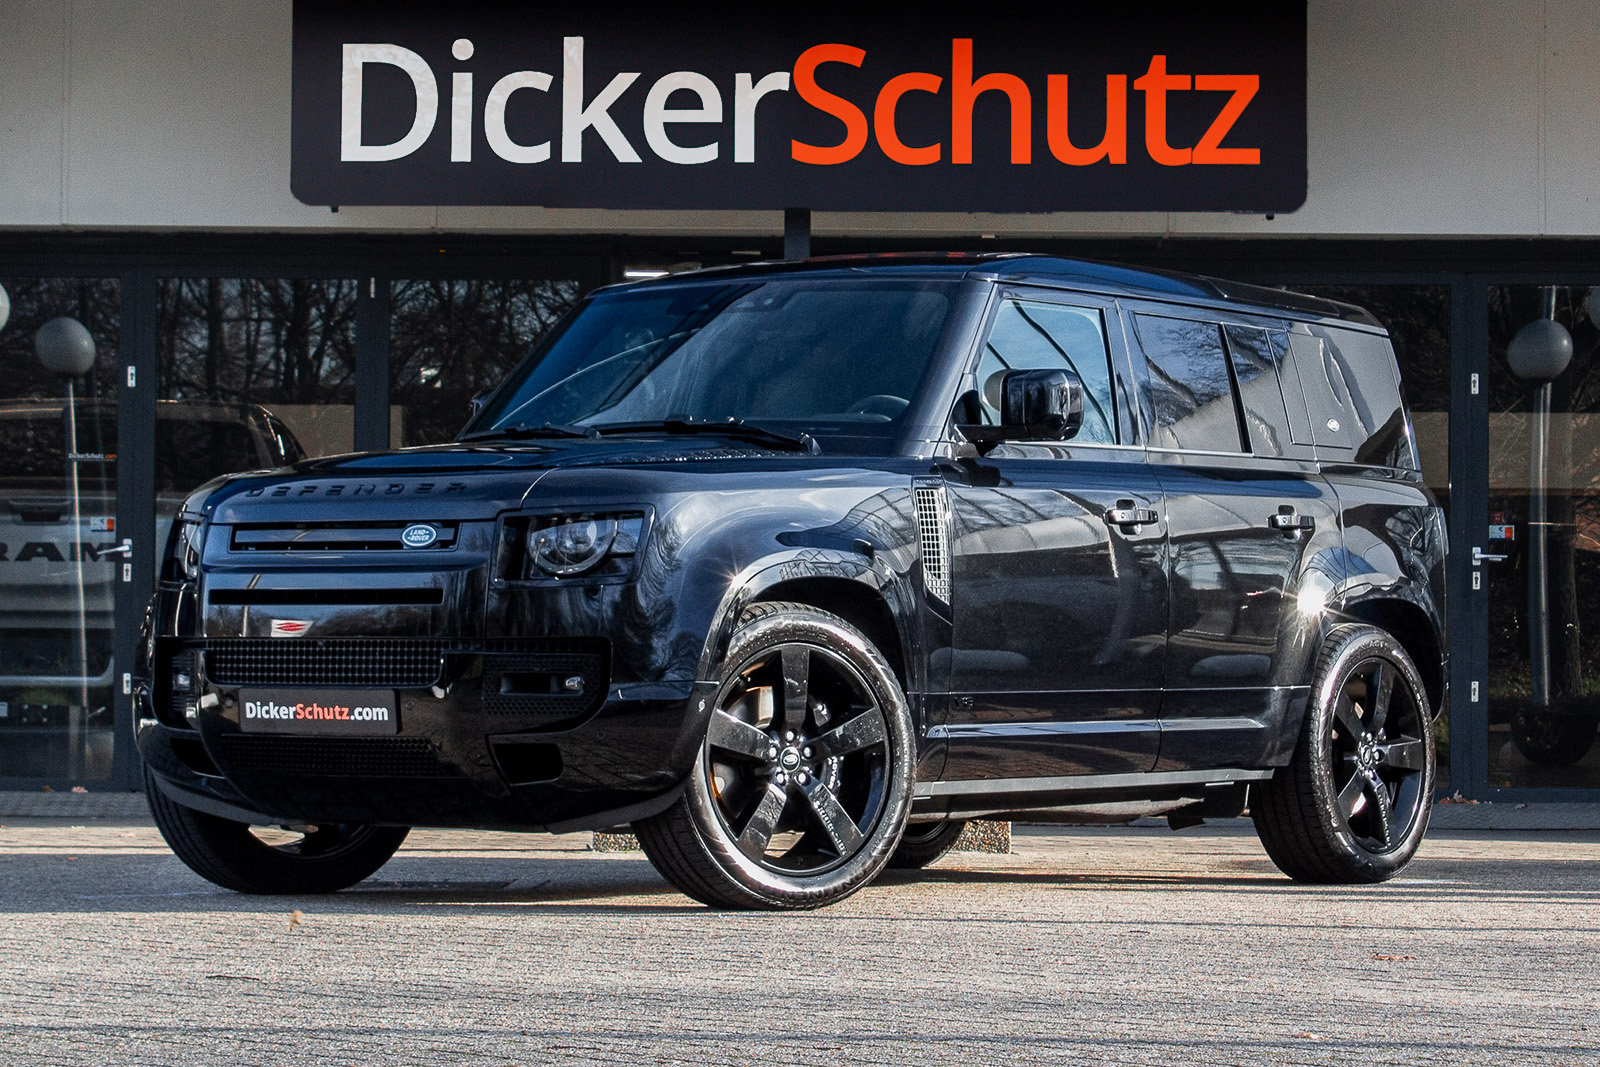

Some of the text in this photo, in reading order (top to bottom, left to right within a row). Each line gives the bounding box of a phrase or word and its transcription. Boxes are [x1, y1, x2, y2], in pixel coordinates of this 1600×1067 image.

[340, 36, 1262, 166] DickerSchutz
[245, 482, 467, 497] DEFENDER
[0, 541, 118, 562] AM
[245, 701, 389, 721] DickerSchutz.com
